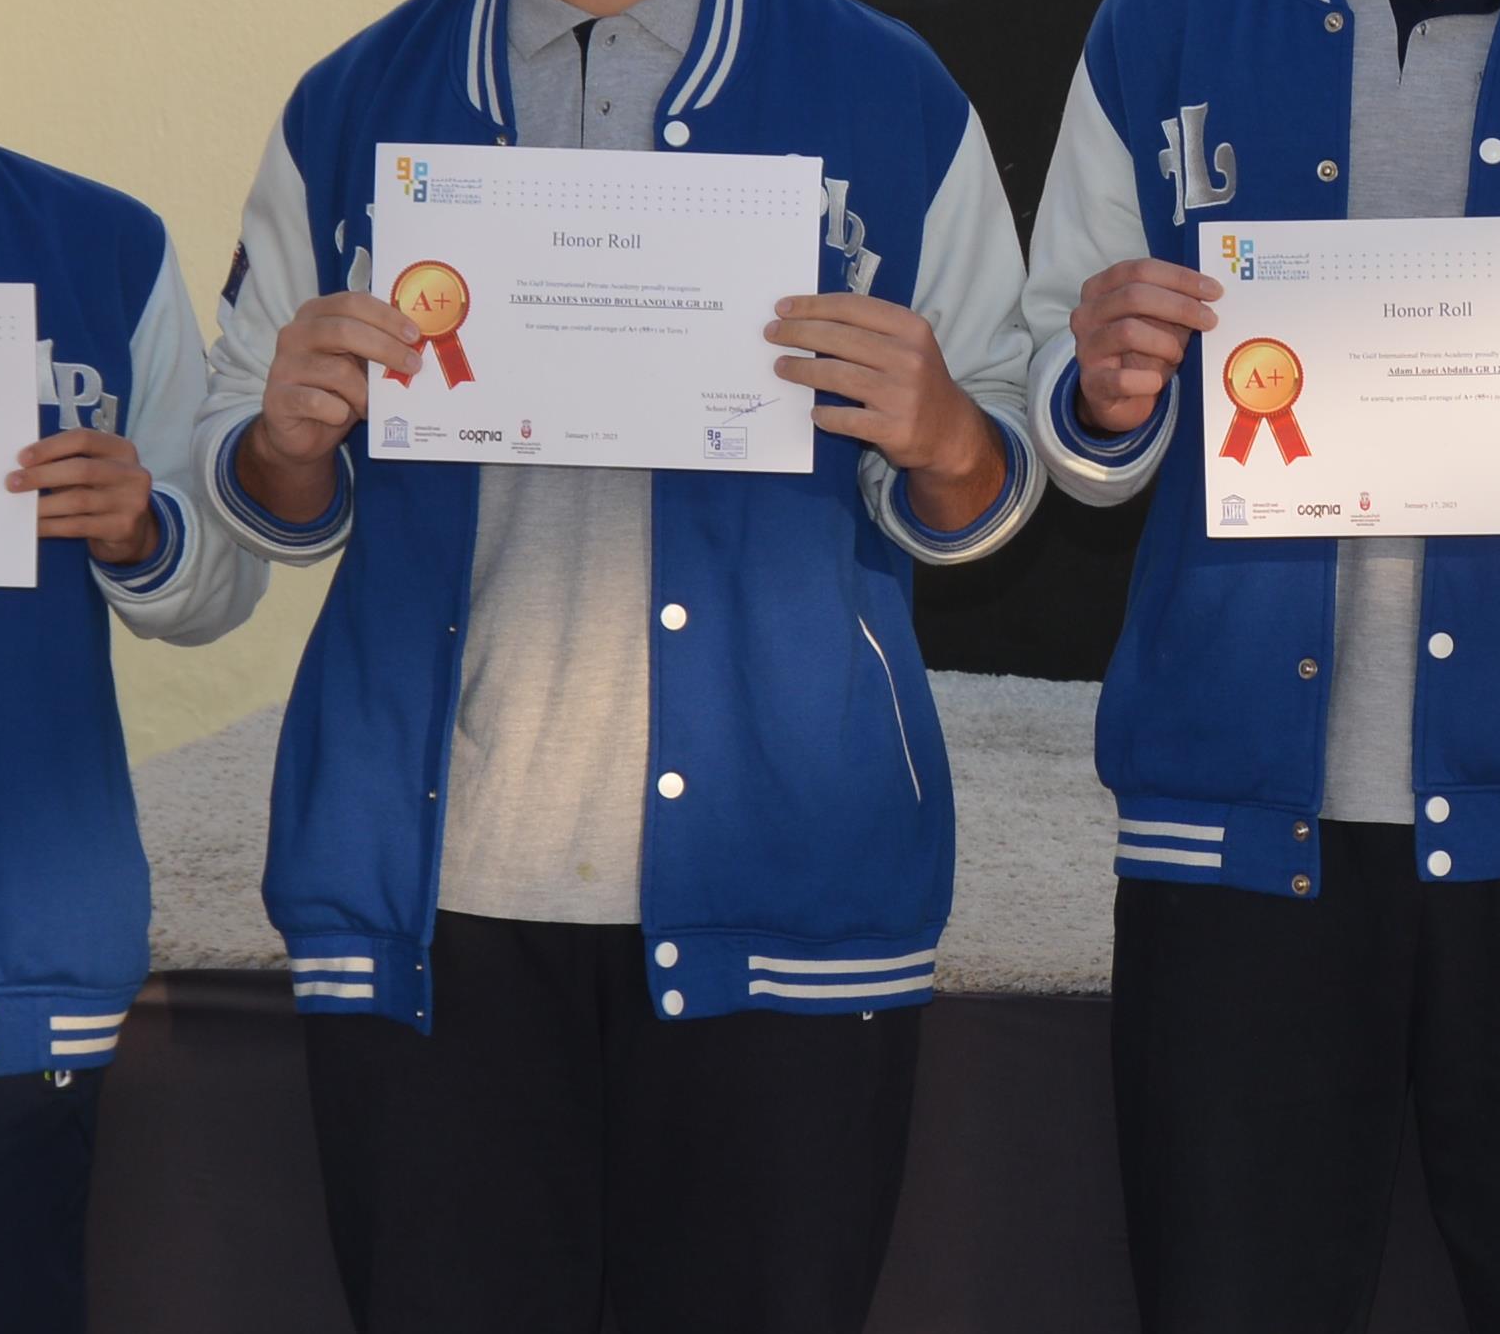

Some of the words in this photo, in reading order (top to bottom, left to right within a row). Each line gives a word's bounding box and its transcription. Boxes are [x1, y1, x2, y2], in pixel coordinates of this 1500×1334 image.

[552, 231, 603, 247] Honor
[608, 233, 640, 248] Roll
[411, 289, 452, 313] A+
[546, 295, 577, 303] JAMES
[580, 296, 611, 304] WOOD
[1383, 302, 1433, 317] Honor
[1439, 301, 1471, 316] Roll
[1475, 365, 1489, 373] GR
[1245, 367, 1285, 390] A+
[459, 429, 501, 443] cognia
[1297, 504, 1340, 518] cognia
